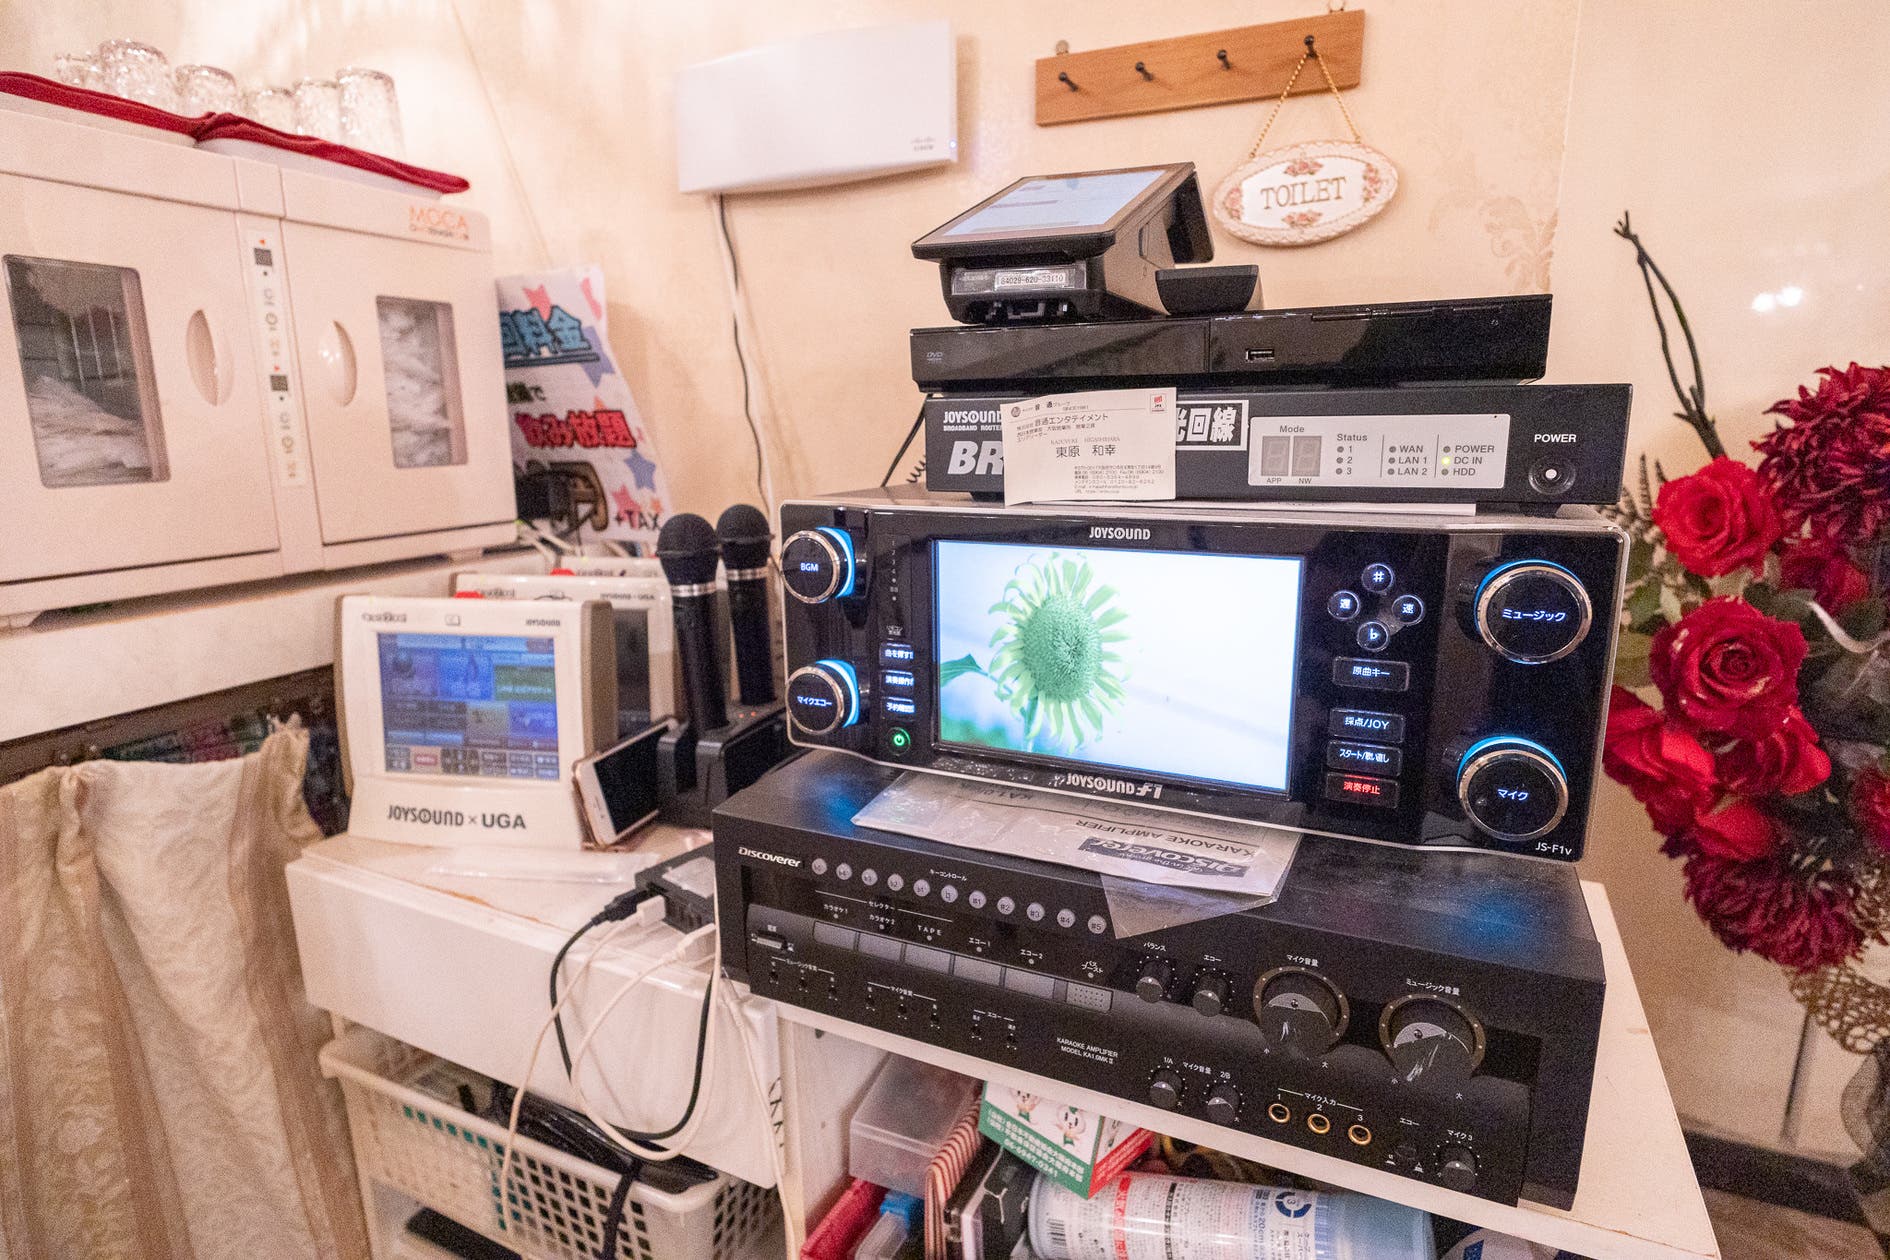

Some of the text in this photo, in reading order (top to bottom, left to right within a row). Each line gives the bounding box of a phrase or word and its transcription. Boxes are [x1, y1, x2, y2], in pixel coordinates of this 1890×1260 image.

[1260, 176, 1347, 210] TOILET
[514, 410, 637, 448] 飲み放題
[980, 424, 1002, 432] ROUTE
[1279, 425, 1305, 433] Mode
[1336, 433, 1368, 442] Status
[1533, 433, 1577, 444] POWER
[1056, 444, 1117, 458] 東原 和幸
[1348, 445, 1353, 453] 1
[1399, 445, 1424, 453] WAN
[1454, 445, 1495, 453] POWER
[1347, 456, 1353, 464] 2
[1398, 456, 1428, 464] LAN 1
[1454, 456, 1482, 465] DC IN
[1346, 467, 1352, 475] 3
[1398, 467, 1428, 475] LAN 2
[1453, 467, 1476, 476] HDD
[1266, 477, 1282, 485] APP
[1298, 477, 1311, 485] NW
[1089, 526, 1151, 540] JOYSOUND
[800, 562, 819, 572] BGM
[1402, 603, 1415, 614] 速
[1502, 608, 1567, 622] ミュージック
[1352, 665, 1390, 677] 原曲キー
[797, 695, 833, 707] マイクエコー
[1345, 716, 1390, 730] 採点/JOY
[1066, 772, 1135, 796] JOYSOUND
[1343, 781, 1381, 795] 演奏停止
[1497, 788, 1529, 801] マイク
[387, 804, 464, 827] JOYSOUND
[481, 813, 527, 830] UGA
[1075, 819, 1257, 858] KARAOKE AMPLIFIER
[737, 846, 801, 868] Discoverer
[868, 901, 895, 910] セレクター
[917, 925, 942, 936] TAPE
[1143, 942, 1167, 952] バランス
[1203, 954, 1222, 962] エコー
[1286, 954, 1319, 968] マイク音量
[1405, 978, 1461, 996] ミュージック音量
[1056, 1036, 1119, 1058] KARAOKE AMPLIFIER
[1060, 1046, 1082, 1058] MODEL
[1304, 1092, 1338, 1106] マイク入力
[1357, 1114, 1363, 1122] 3
[1399, 1117, 1420, 1126] エコー
